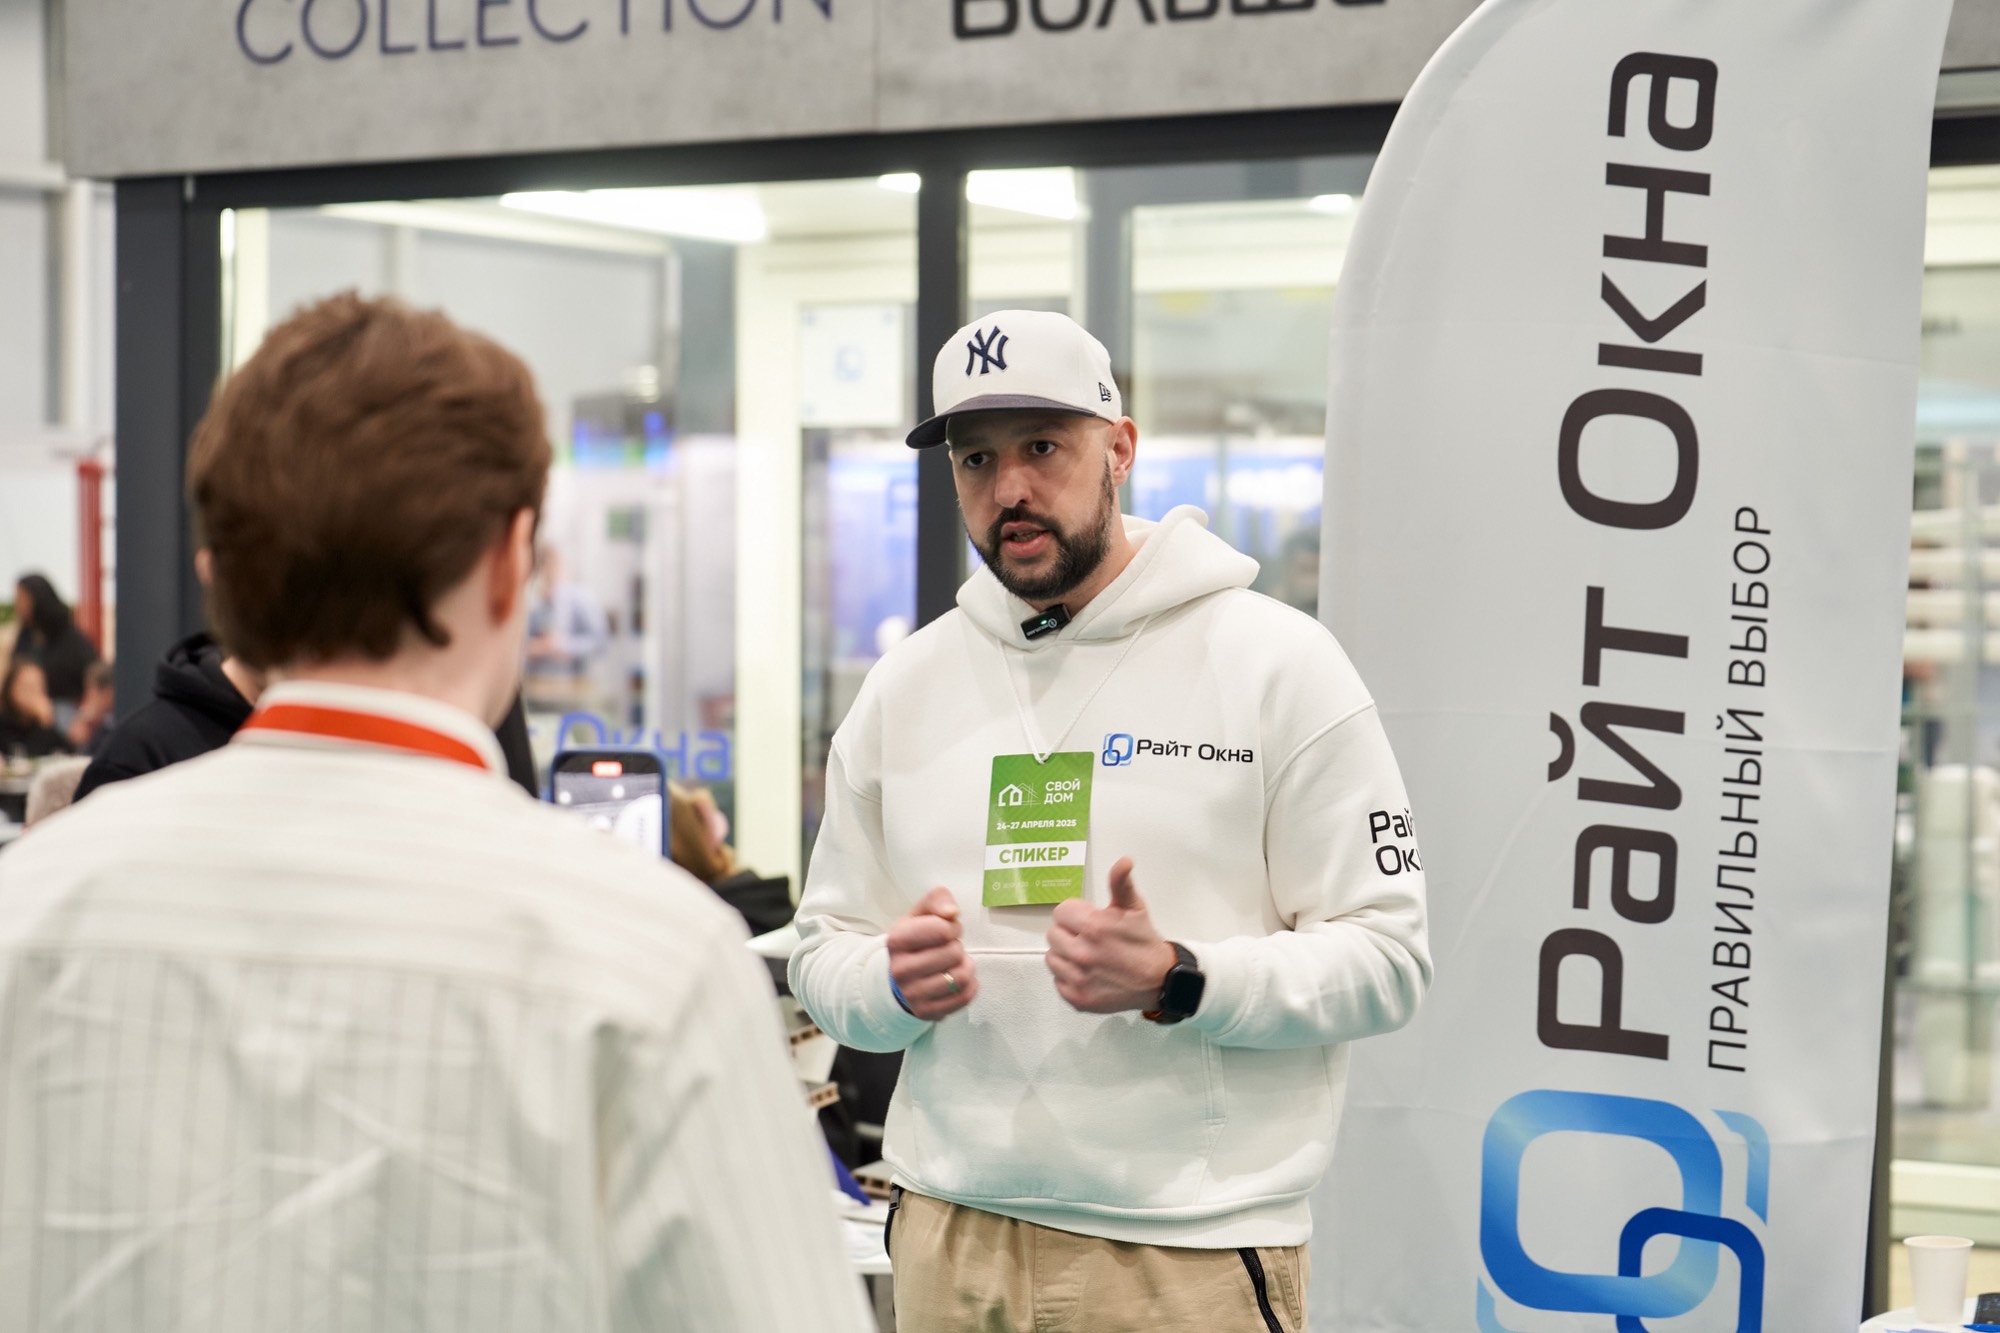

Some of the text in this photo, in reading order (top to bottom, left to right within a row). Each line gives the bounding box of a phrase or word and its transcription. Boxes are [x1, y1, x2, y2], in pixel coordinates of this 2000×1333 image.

[1537, 51, 1718, 1060] Райт Окна
[1136, 739, 1254, 763] Райт Окна
[1045, 778, 1081, 792] СВОЙ
[1707, 505, 1772, 1073] ПРАВИЛЬНЫЙ ВЫБОР
[1043, 792, 1074, 805] ДОМ
[1021, 820, 1055, 829] АПРЕЛЯ
[1055, 819, 1077, 828] 2025
[998, 846, 1069, 864] СПИКЕР
[1375, 844, 1423, 876] Ок
